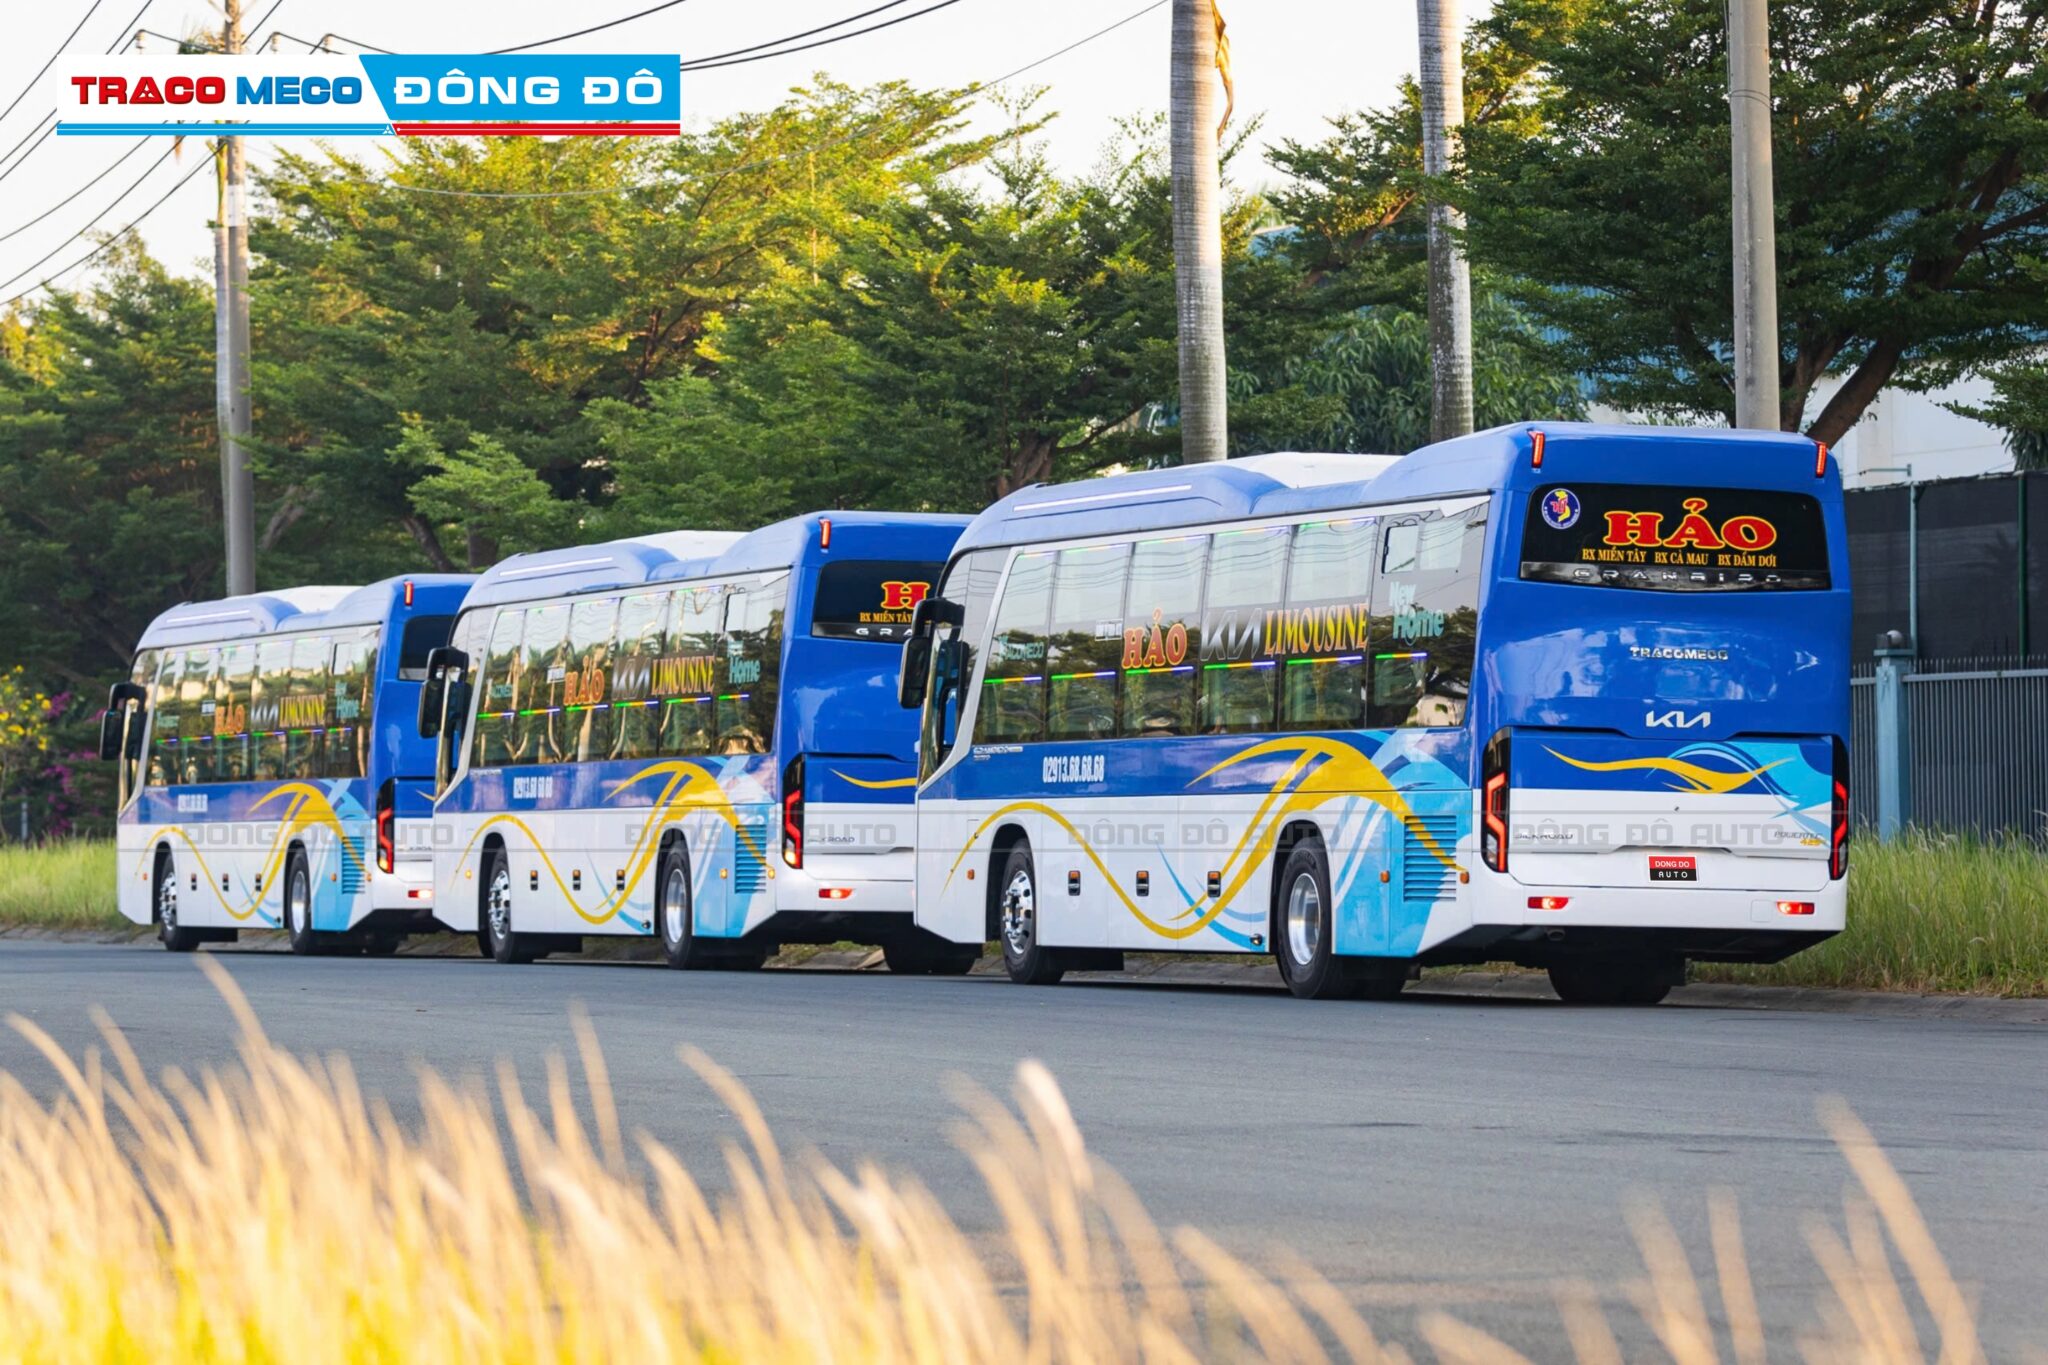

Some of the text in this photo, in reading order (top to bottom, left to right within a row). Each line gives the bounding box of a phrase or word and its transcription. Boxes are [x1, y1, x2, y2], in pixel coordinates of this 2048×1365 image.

[1603, 497, 1777, 551] HẢO
[1582, 548, 1596, 560] BX
[1627, 548, 1647, 563] TÂY
[1654, 552, 1668, 564] BX
[1686, 552, 1709, 565] MAU
[1717, 553, 1732, 566] BX
[1392, 604, 1445, 640] Home
[1121, 600, 1369, 669] HẢO KIA LIMOUSINE
[1629, 646, 1729, 660] TRACOMECO
[651, 652, 716, 696] LIMOUSINE
[1645, 710, 1711, 729] KIA
[1042, 755, 1105, 783] 02913.68.68.68
[1655, 860, 1677, 868] DONG
[1658, 871, 1688, 879] AUTO
